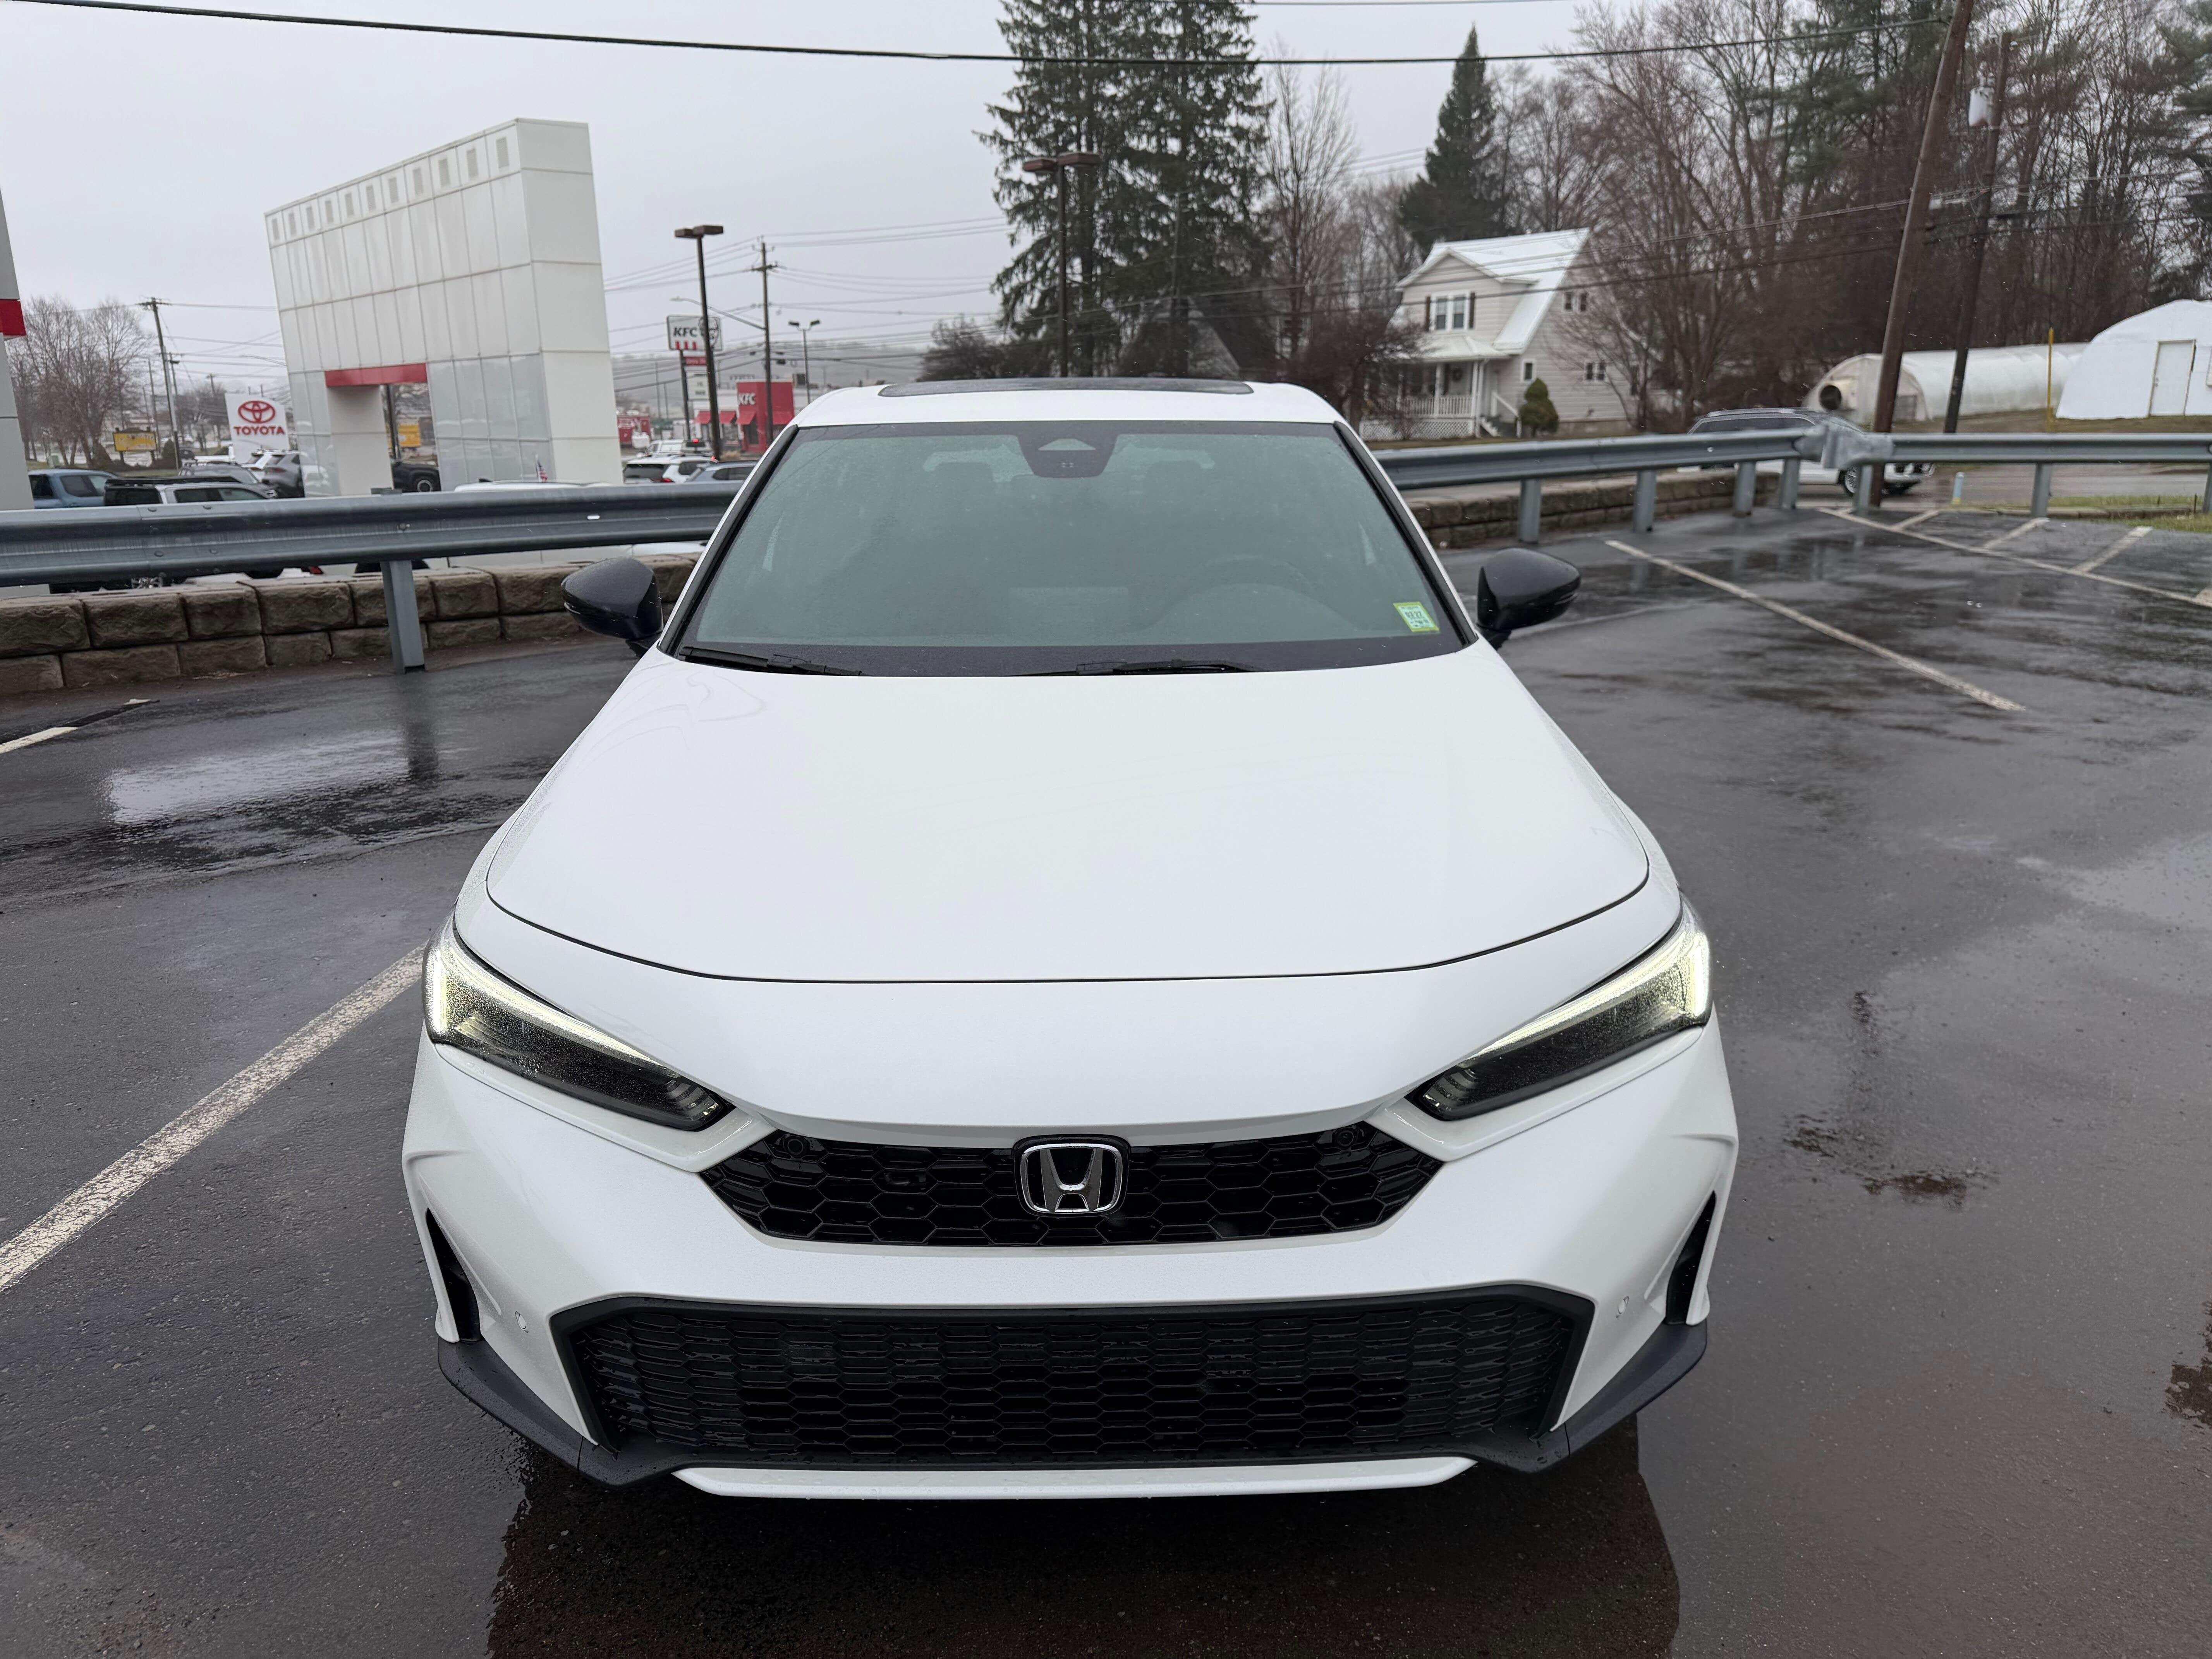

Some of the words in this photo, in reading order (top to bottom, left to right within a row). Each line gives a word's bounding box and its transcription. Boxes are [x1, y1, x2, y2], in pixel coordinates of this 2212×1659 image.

[673, 327, 698, 337] KFC
[738, 393, 756, 405] KFC
[234, 426, 285, 435] TOYOTA
